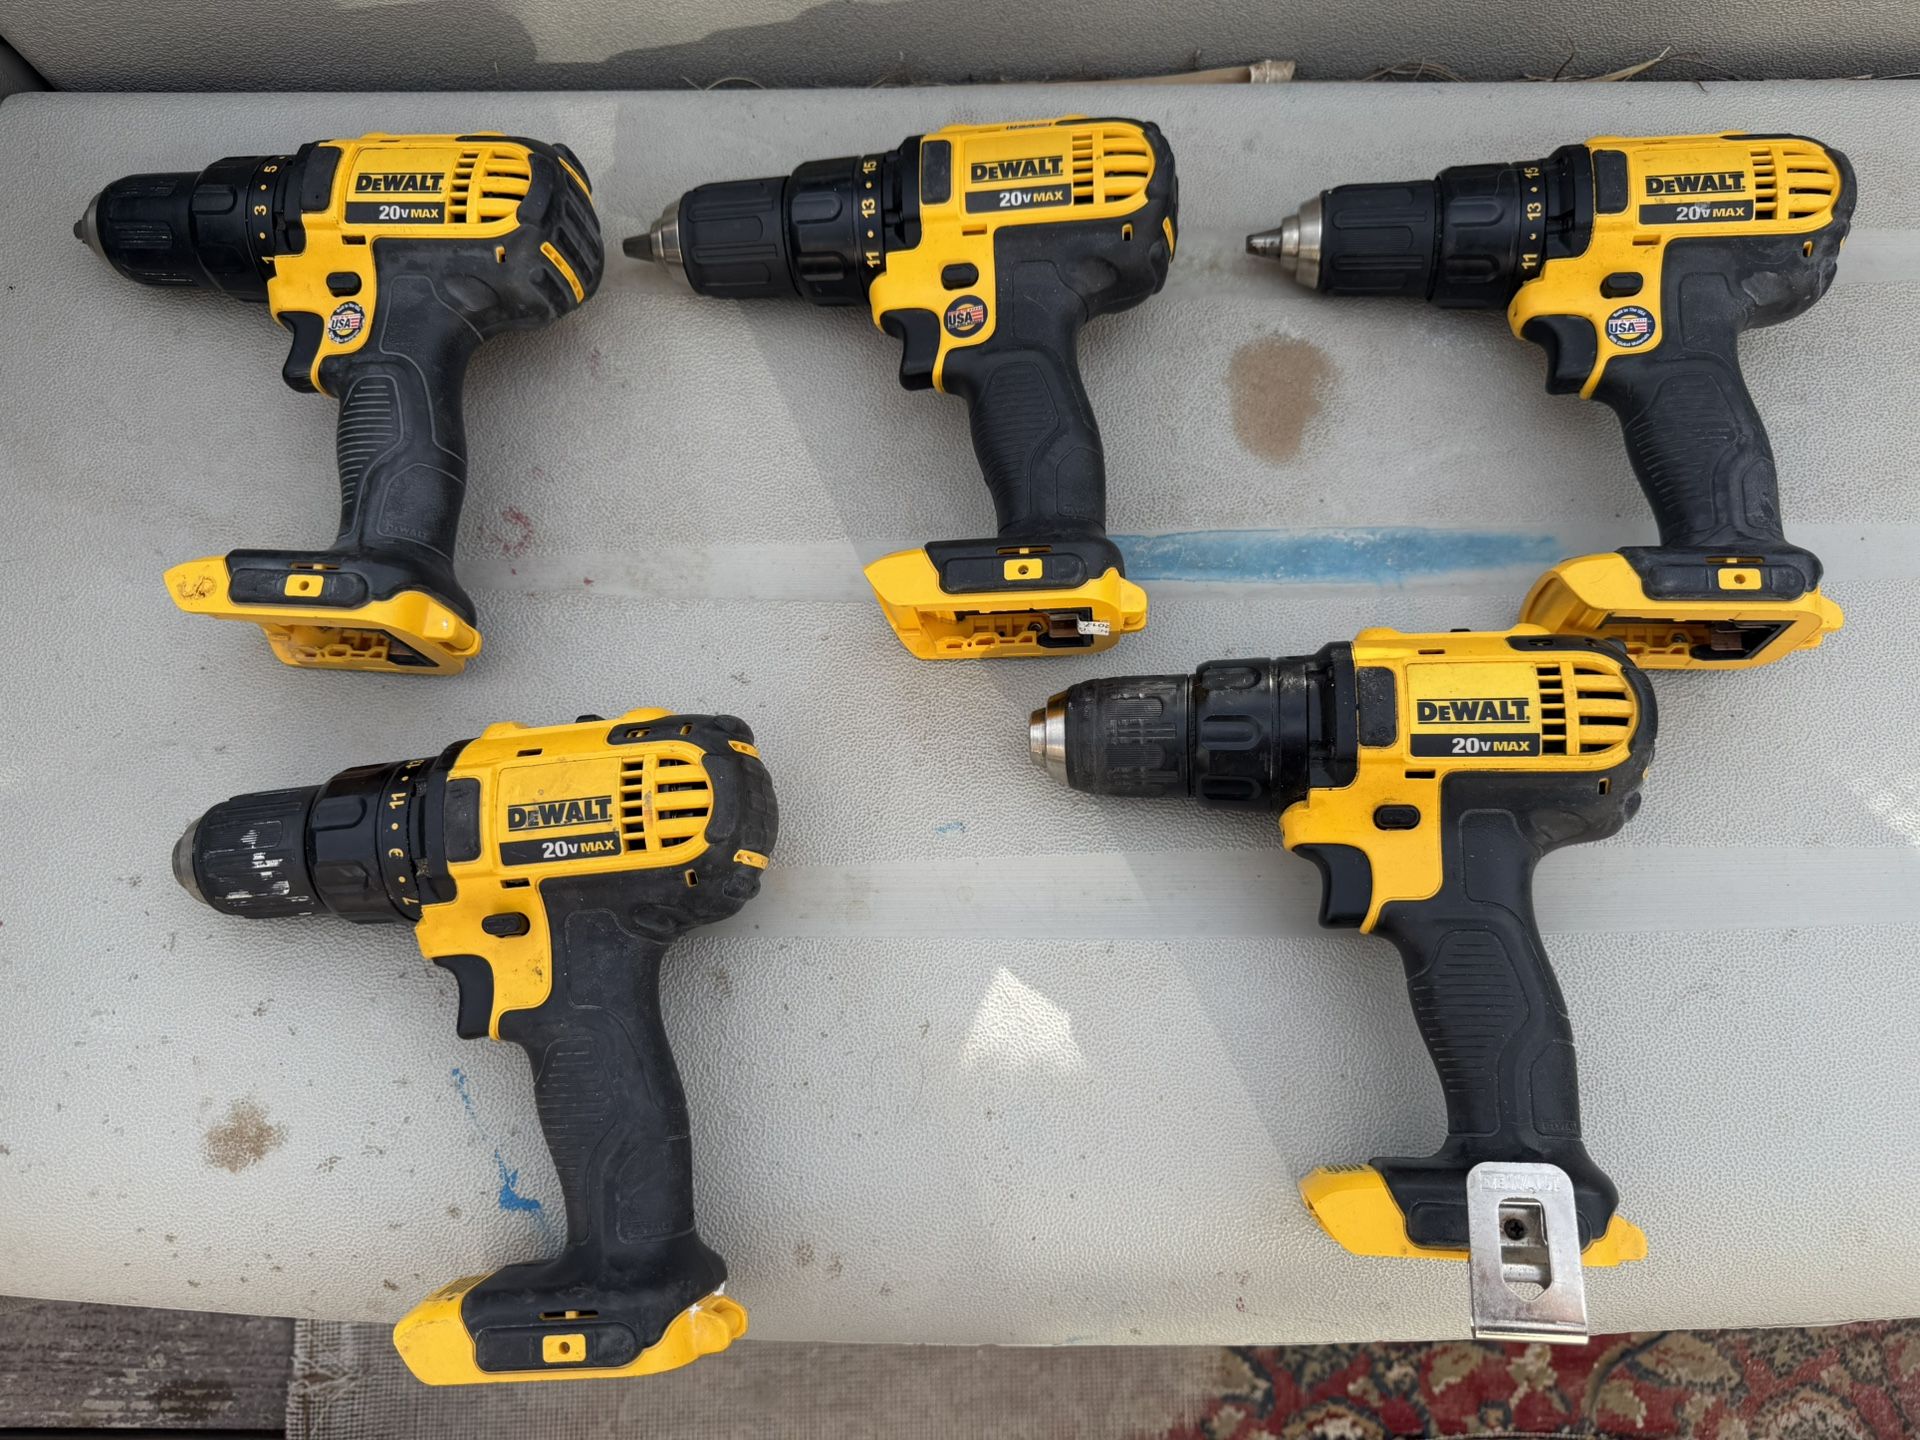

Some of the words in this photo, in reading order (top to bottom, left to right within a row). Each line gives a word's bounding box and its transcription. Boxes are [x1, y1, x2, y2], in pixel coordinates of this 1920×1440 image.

[263, 164, 278, 173] 5
[862, 160, 878, 174] 15
[1033, 191, 1064, 203] MAX
[254, 204, 267, 216] 3
[410, 208, 439, 219] MAX
[862, 198, 876, 219] 13
[1526, 202, 1542, 221] 13
[1712, 206, 1745, 218] MAX
[866, 251, 881, 268] 11
[1521, 253, 1538, 270] 11
[331, 317, 351, 330] USA
[948, 311, 973, 325] USA
[1610, 322, 1636, 333] USA
[1493, 741, 1530, 752] MAX
[389, 792, 407, 809] 11
[580, 839, 615, 854] MAX
